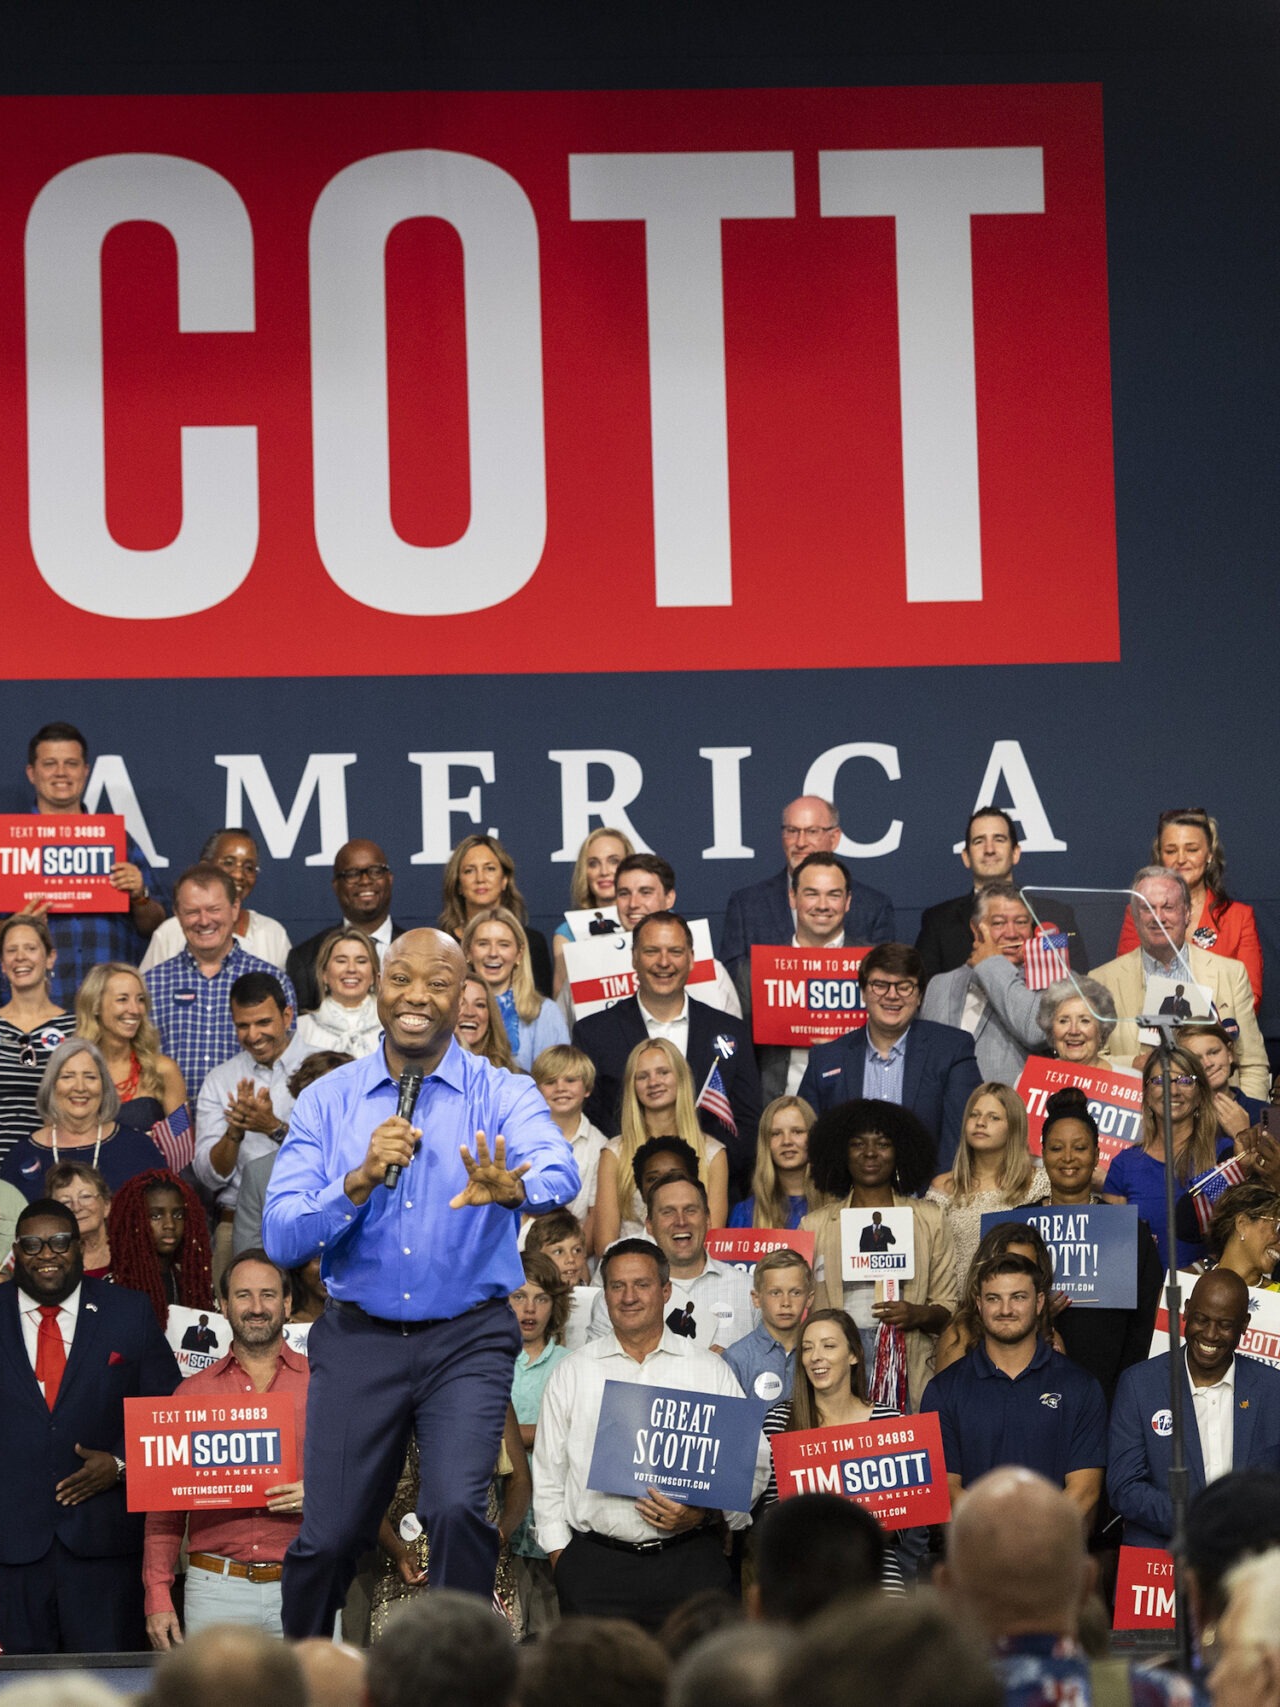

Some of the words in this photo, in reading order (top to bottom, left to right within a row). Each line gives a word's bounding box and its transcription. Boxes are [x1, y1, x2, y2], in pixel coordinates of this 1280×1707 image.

[82, 740, 1067, 868] AMERICA
[10, 826, 33, 838] TEXT
[37, 826, 56, 838] TIM
[59, 826, 71, 838] TO
[43, 846, 114, 875] SCOTT
[774, 959, 799, 971] TEXT
[802, 959, 822, 971] TIM
[826, 960, 839, 972] TO
[842, 960, 862, 972] 348
[600, 976, 630, 998] TIM
[764, 979, 806, 1009] TIM
[809, 980, 867, 1009] SCO
[1045, 1070, 1070, 1085] TEXT
[1072, 1076, 1093, 1090] TIM
[1095, 1081, 1108, 1094] TO
[715, 1241, 733, 1253] TIM
[737, 1241, 750, 1253] TO
[850, 1256, 870, 1269] TIM
[871, 1254, 905, 1268] SCOTT
[190, 1353, 219, 1369] SCO
[152, 1411, 181, 1424] TEXT
[185, 1410, 207, 1422] TIM
[211, 1409, 226, 1422] TO
[230, 1407, 268, 1421] 34883
[650, 1397, 716, 1435] GREAT
[140, 1434, 190, 1467] TIM
[193, 1431, 278, 1465] SCOTT
[632, 1428, 721, 1476] SCOTT!
[800, 1442, 829, 1457] TEXT
[831, 1438, 855, 1452] TIM
[858, 1435, 873, 1449] TO
[877, 1429, 915, 1447] 34883
[225, 1467, 280, 1476] AMERICA
[634, 1471, 711, 1491] VOTETIMSCOTT.COM
[790, 1464, 842, 1496] TIM
[843, 1452, 927, 1493] SCOTT
[171, 1484, 253, 1496] VOTETIMSCOTT.COM
[877, 1487, 932, 1501] AMERICA
[1146, 1562, 1174, 1576] TEXT
[1131, 1584, 1176, 1619] TIM
